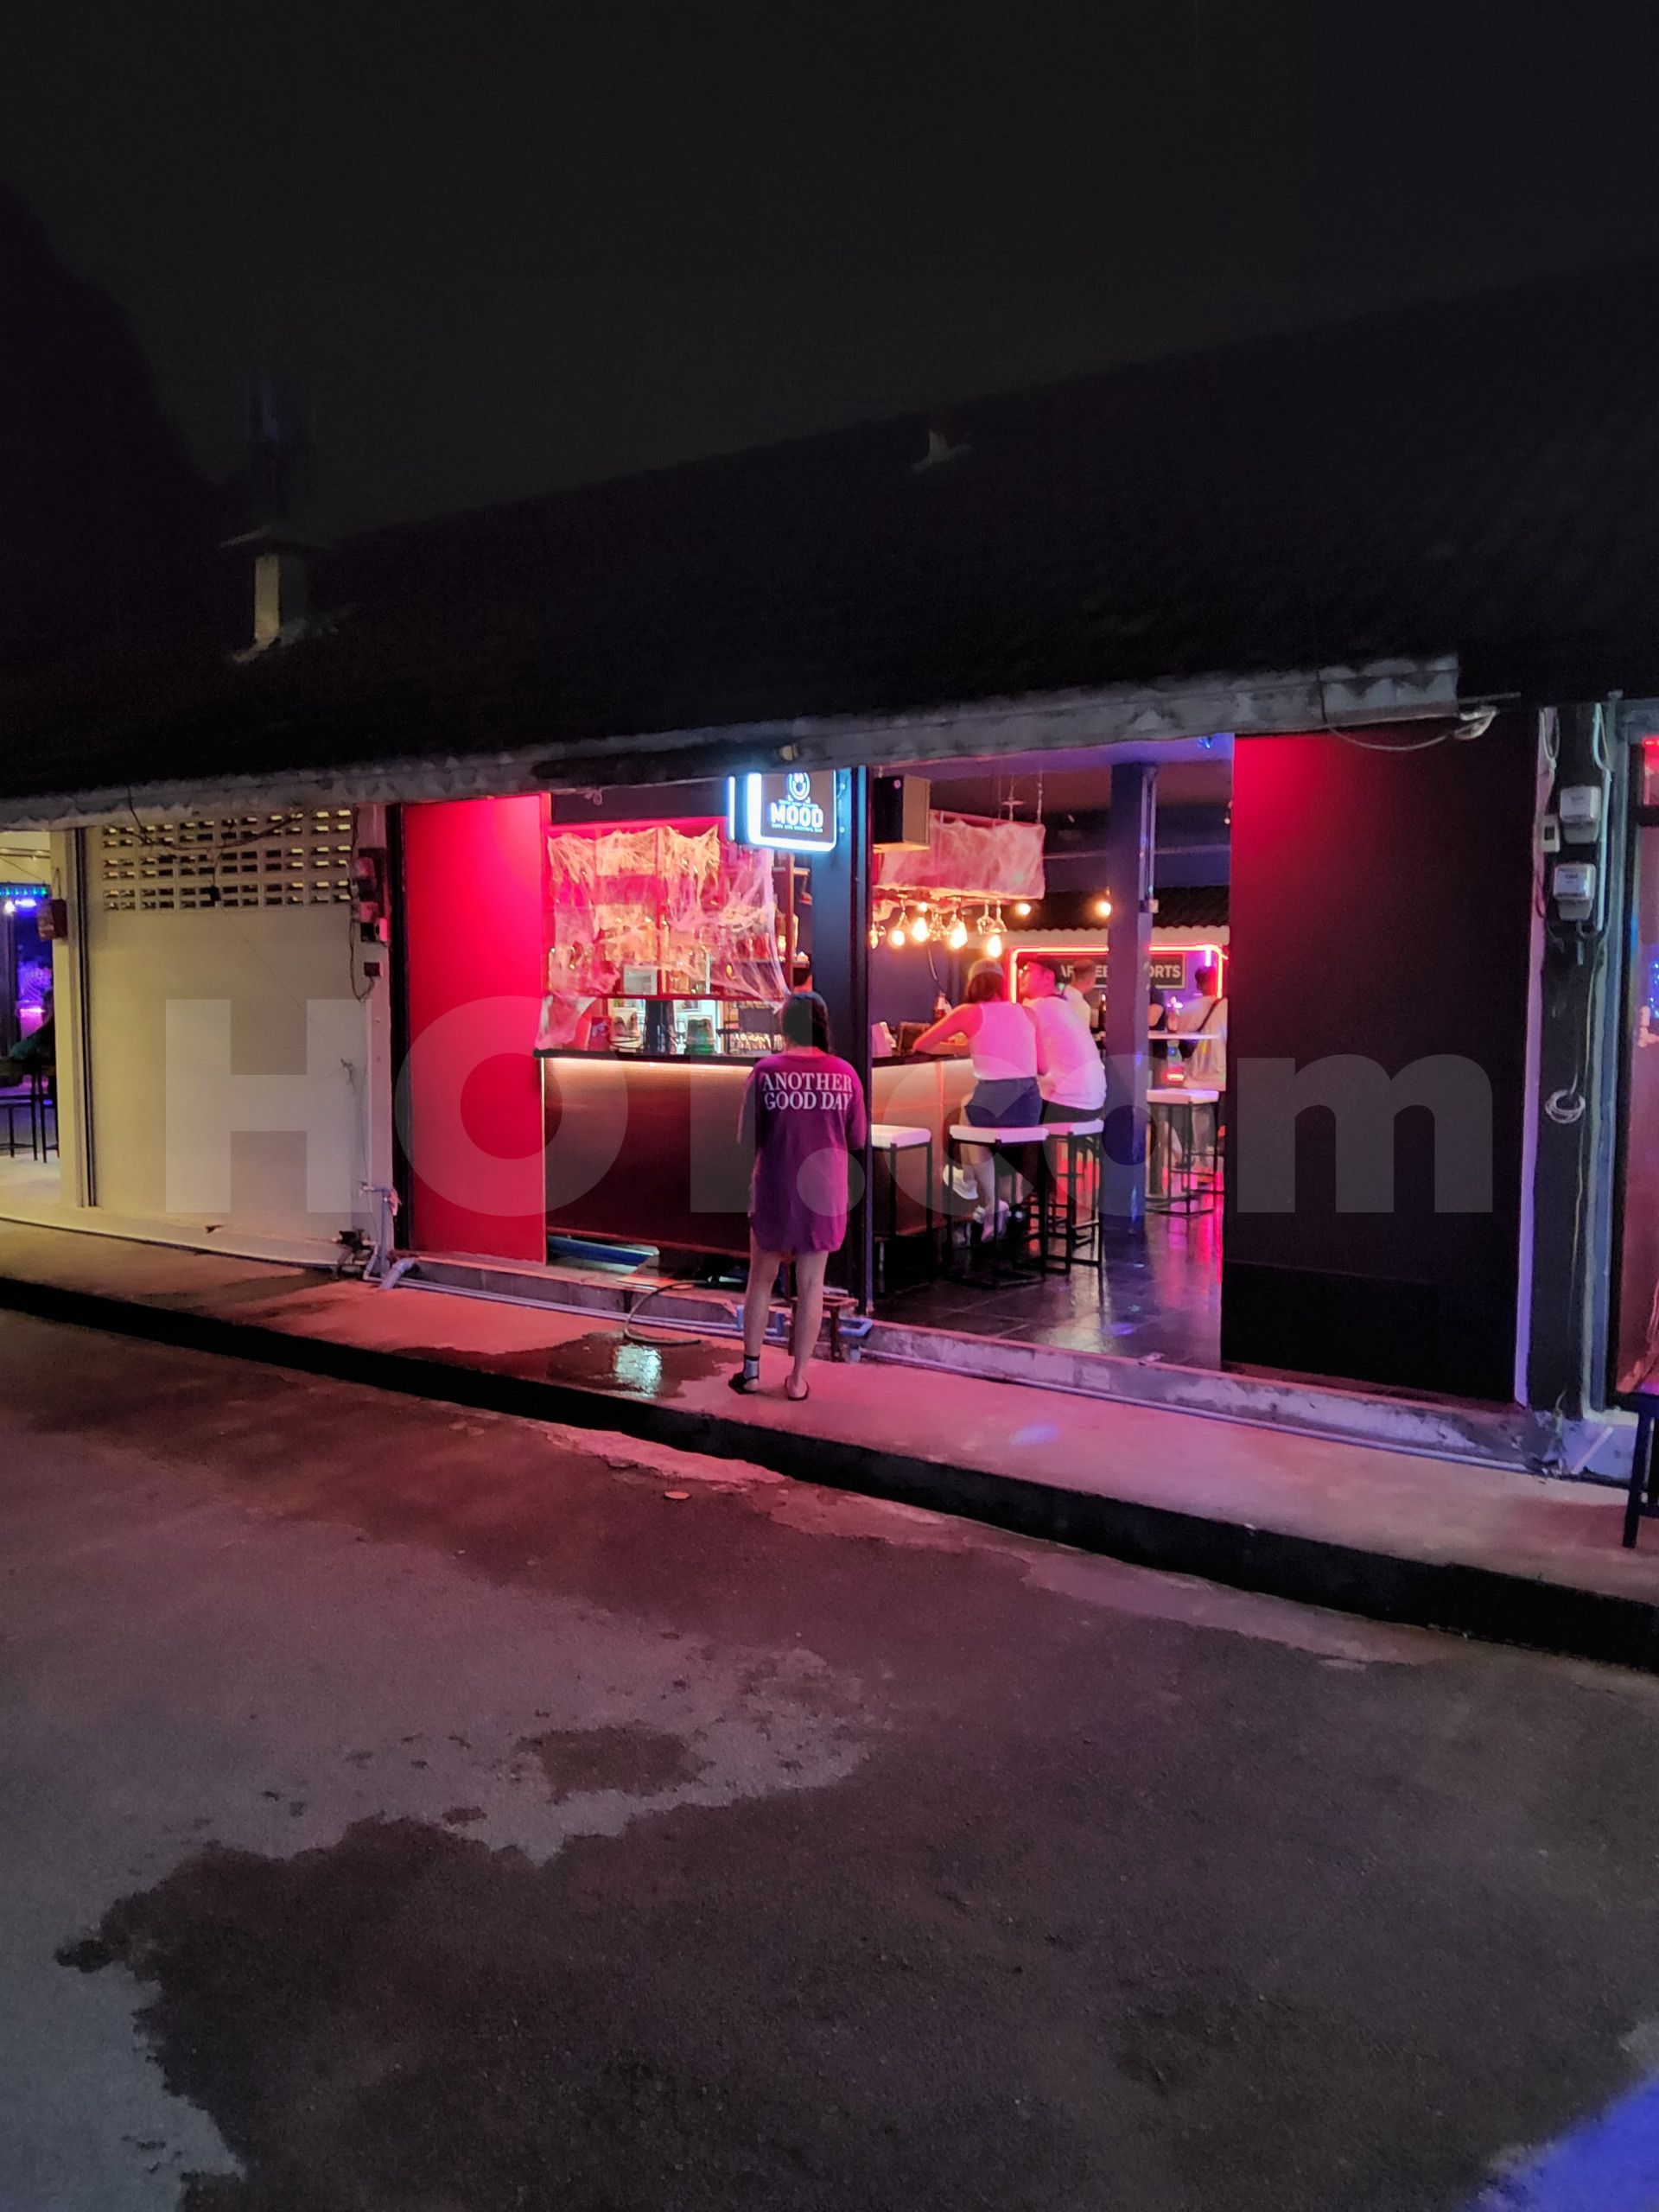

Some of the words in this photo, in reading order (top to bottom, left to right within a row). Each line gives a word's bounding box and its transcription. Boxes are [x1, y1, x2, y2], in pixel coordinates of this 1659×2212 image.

[770, 802, 823, 829] MOOD
[1148, 964, 1181, 979] ORTS
[761, 1071, 853, 1093] ANOTHER
[764, 1090, 817, 1111] GOOD
[820, 1091, 853, 1111] DAY
